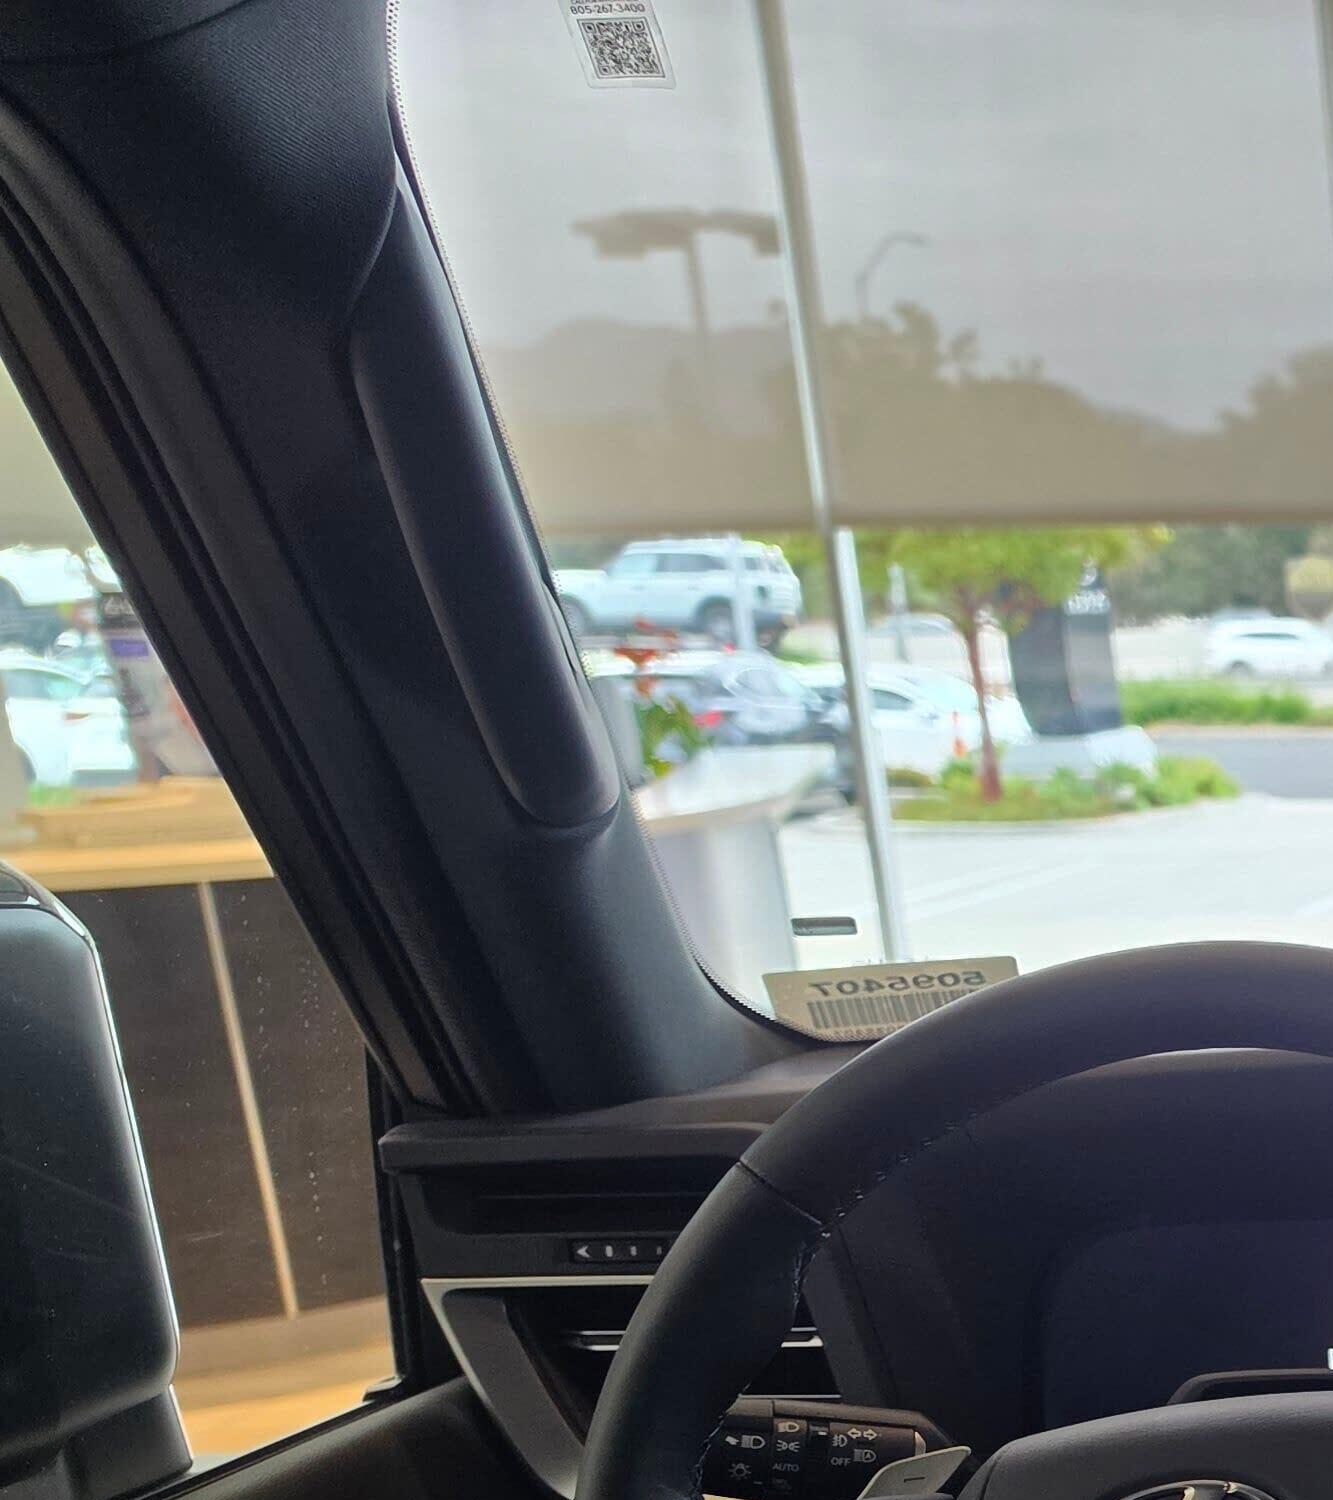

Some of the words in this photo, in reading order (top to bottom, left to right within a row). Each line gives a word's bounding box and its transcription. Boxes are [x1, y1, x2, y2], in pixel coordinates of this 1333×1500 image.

[570, 3, 645, 14] 805-267-3400
[830, 1456, 851, 1467] OFF
[772, 1463, 800, 1472] AUTO
